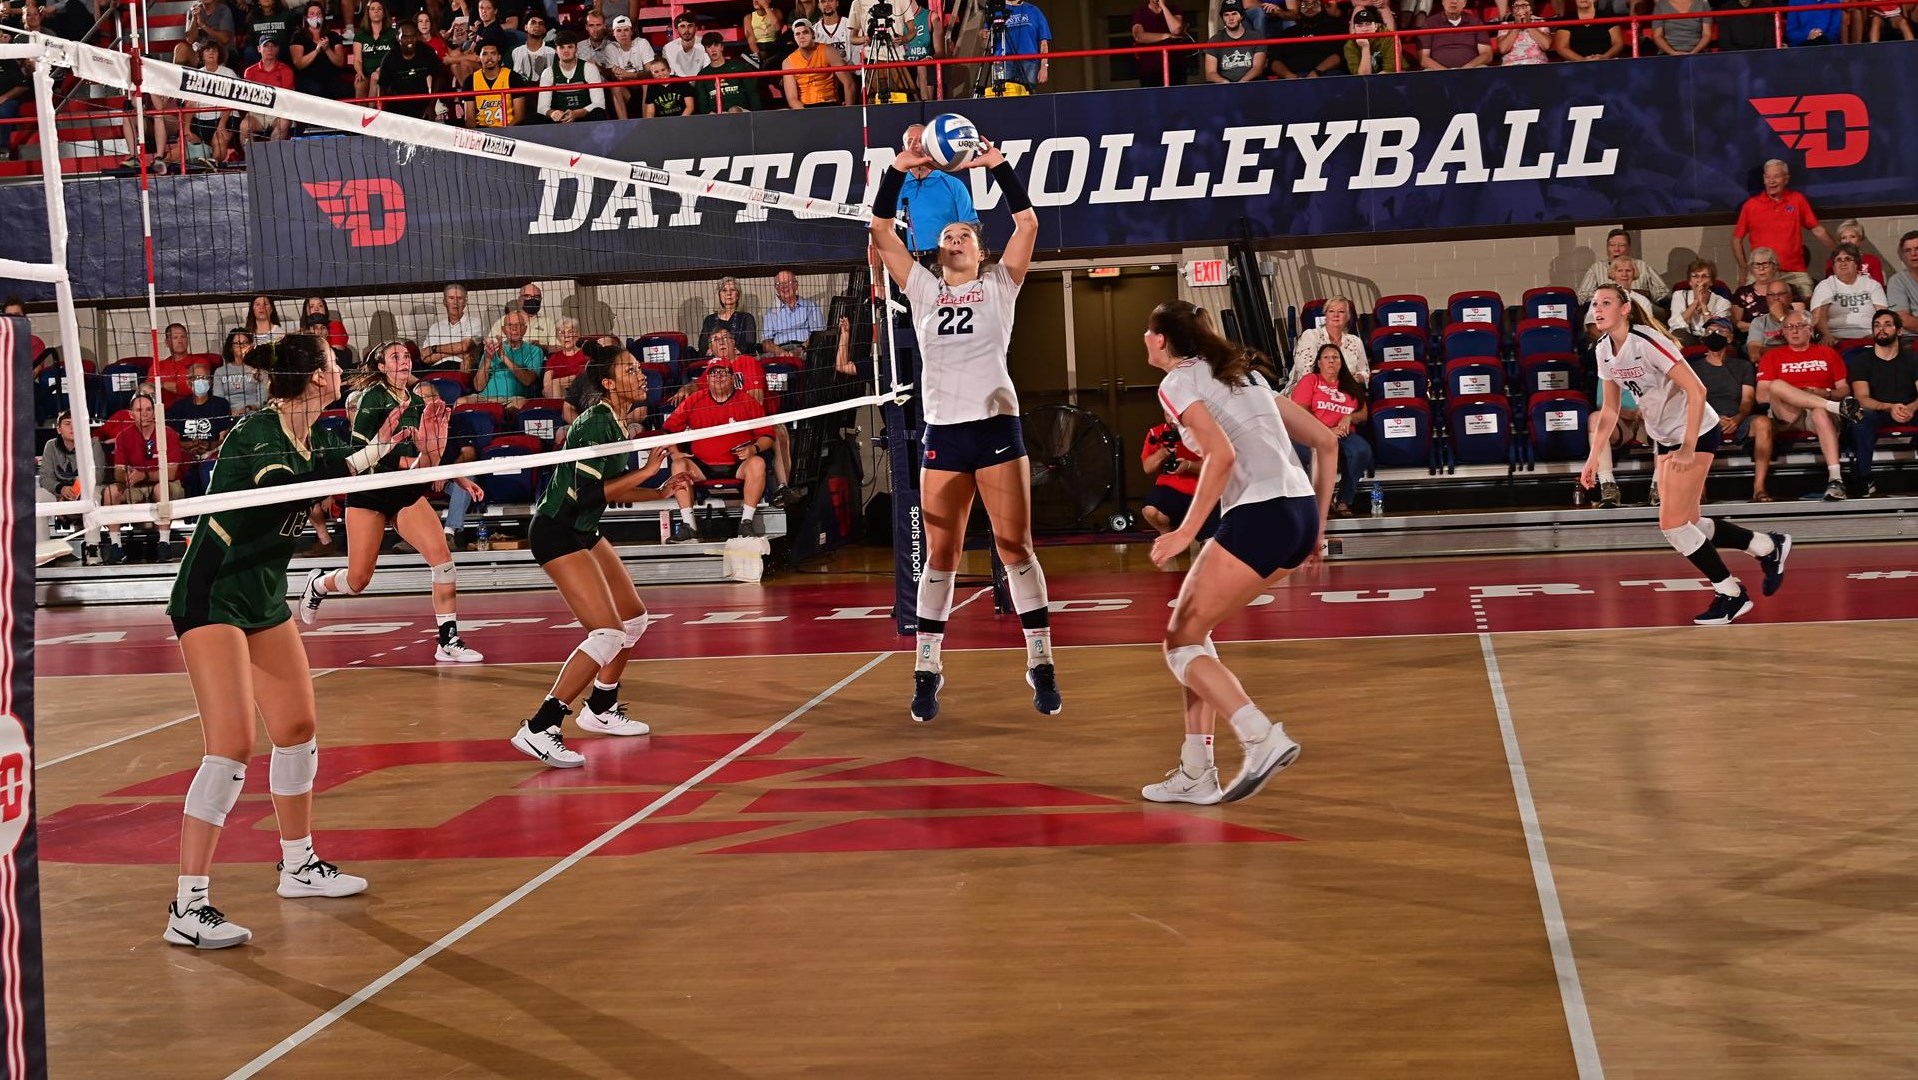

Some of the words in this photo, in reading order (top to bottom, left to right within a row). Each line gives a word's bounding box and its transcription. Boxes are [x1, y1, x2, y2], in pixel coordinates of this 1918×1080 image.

[911, 47, 927, 56] NBA
[186, 71, 231, 98] DAYTON
[232, 79, 275, 107] FLYERS
[484, 109, 503, 125] 24
[453, 128, 484, 151] FLYER
[485, 135, 514, 156] LEGACY
[969, 105, 1620, 211] VOLLEYBALL
[1194, 261, 1222, 282] EXIT
[937, 306, 974, 336] 22
[1781, 360, 1828, 369] FLYERS
[1316, 400, 1355, 415] DAYTON
[909, 505, 922, 540] sports
[910, 540, 922, 583] imports
